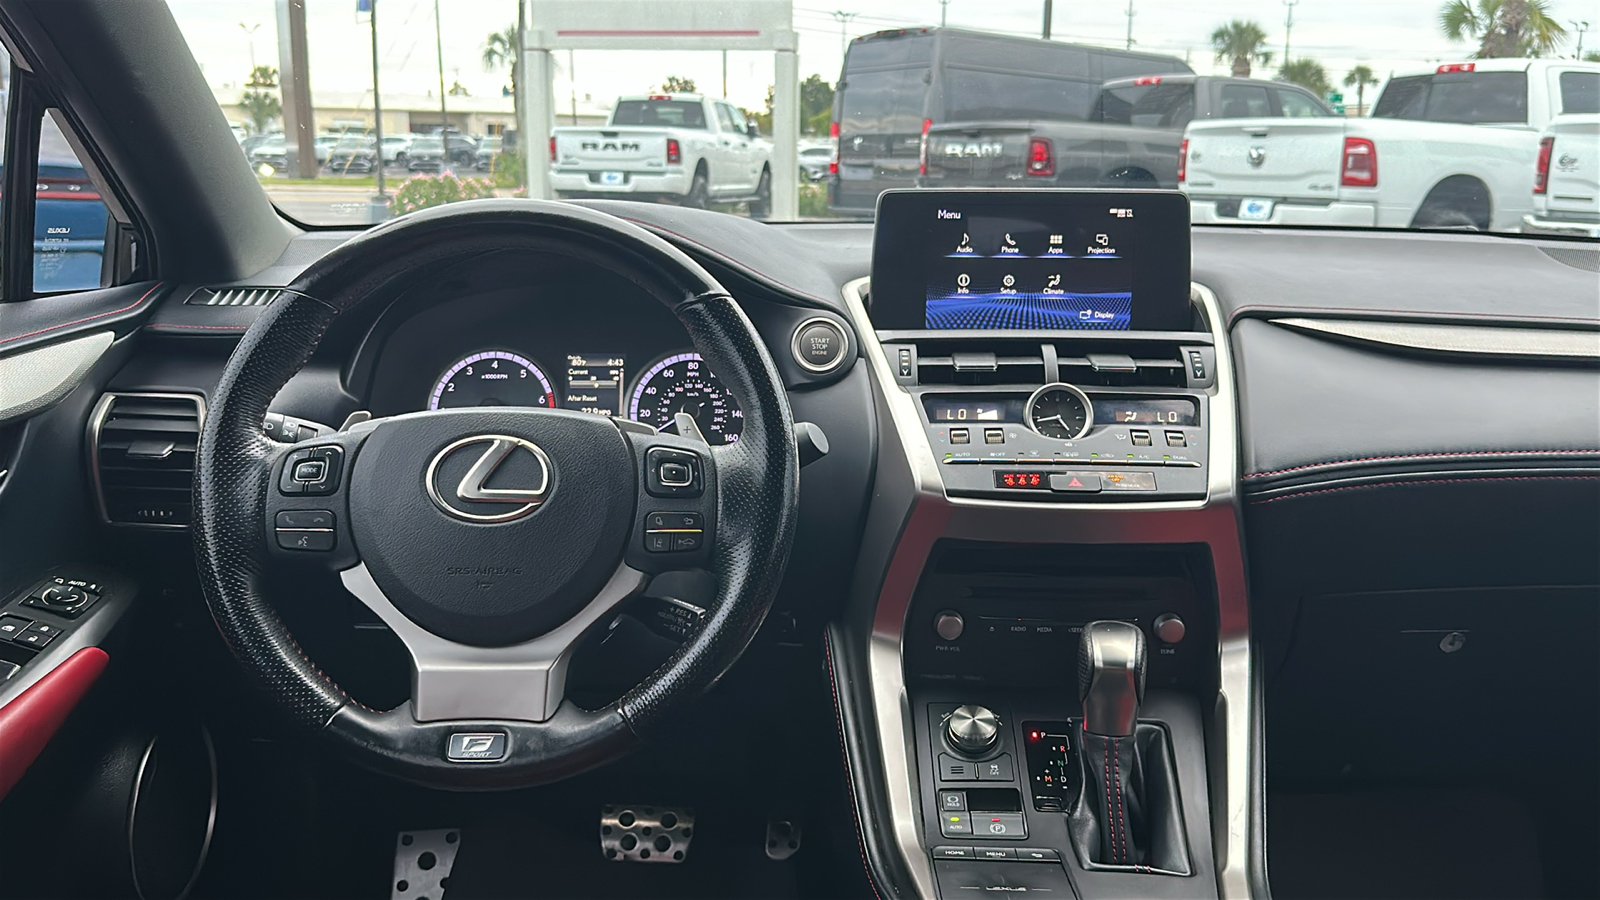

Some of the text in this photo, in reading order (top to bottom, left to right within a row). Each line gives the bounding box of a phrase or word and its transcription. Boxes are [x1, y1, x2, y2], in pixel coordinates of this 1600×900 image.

[582, 142, 640, 151] RAM
[945, 143, 1003, 158] RAM
[937, 209, 961, 219] Menu
[1048, 246, 1063, 254] Apps
[1087, 246, 1116, 254] Projection
[1000, 287, 1017, 295] Setup
[491, 360, 499, 369] 4
[607, 359, 624, 367] 4:43
[688, 362, 699, 370] 80
[466, 366, 474, 375] 3
[520, 369, 527, 378] 5
[663, 370, 675, 378] 60
[447, 383, 455, 392] 2
[645, 387, 657, 395] 40
[538, 396, 546, 405] 6
[639, 409, 651, 418] 20
[724, 433, 739, 442] 160
